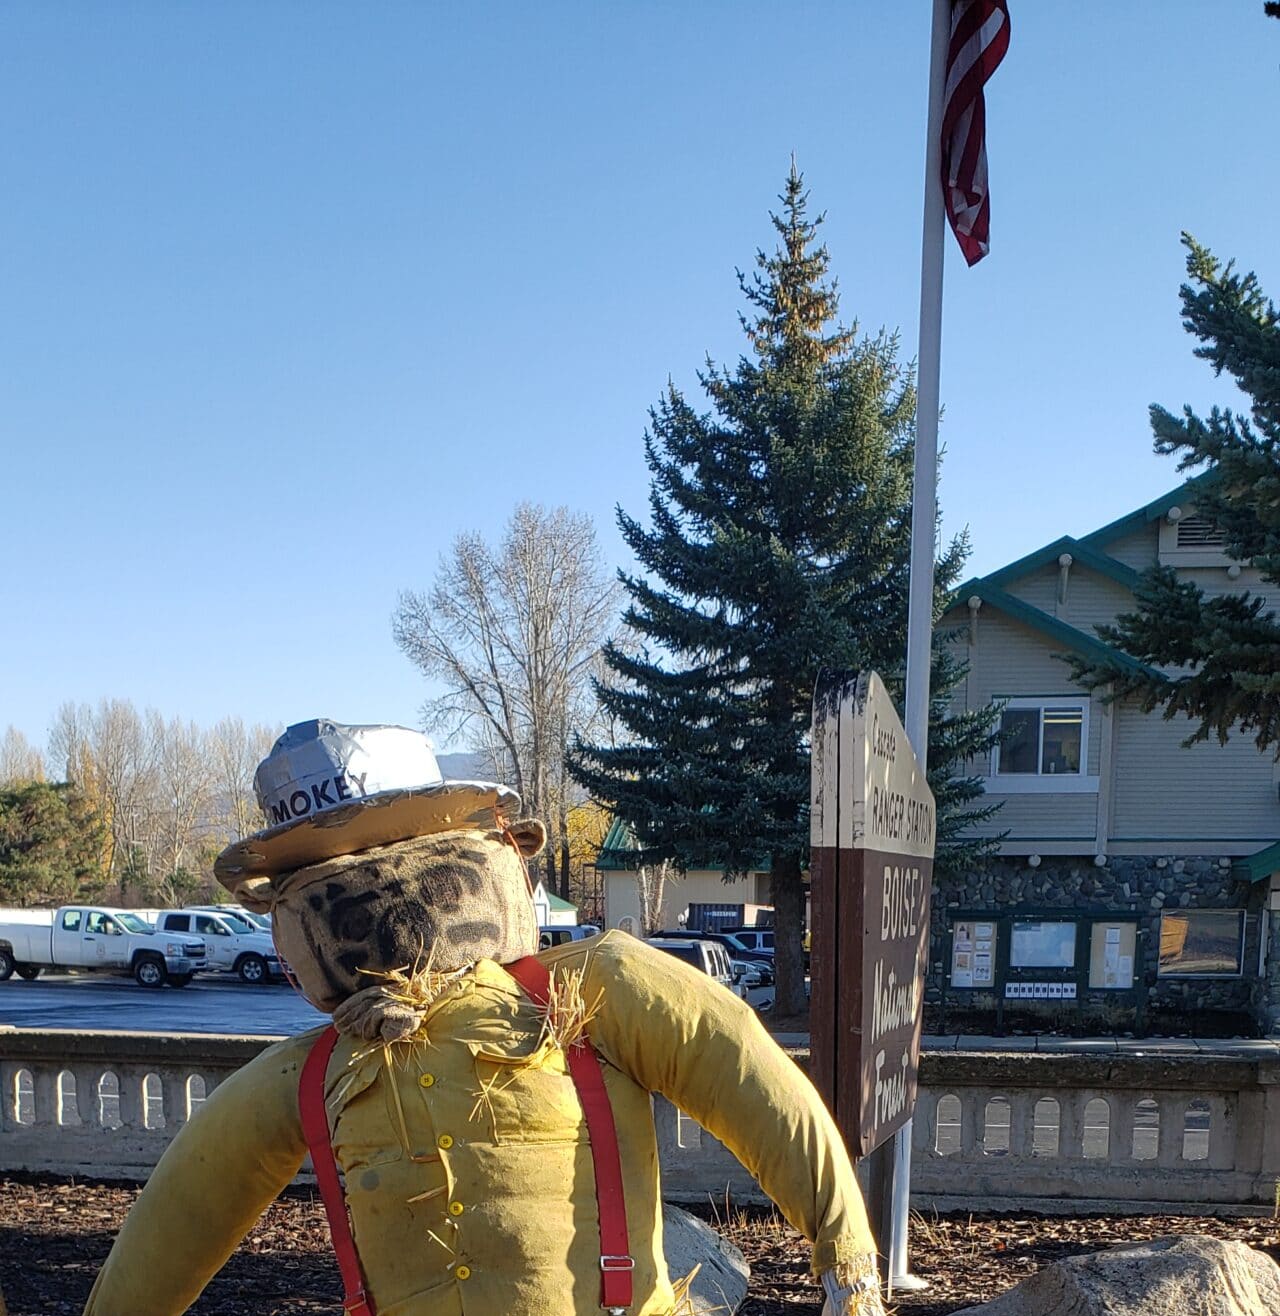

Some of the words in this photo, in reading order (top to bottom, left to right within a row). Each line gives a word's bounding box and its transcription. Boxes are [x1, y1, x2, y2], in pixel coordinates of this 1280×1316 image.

[872, 786, 905, 840] RANGER
[906, 798, 933, 845] STATION
[881, 866, 919, 941] BOISE
[871, 952, 919, 1044] National
[874, 1047, 909, 1130] Forest
